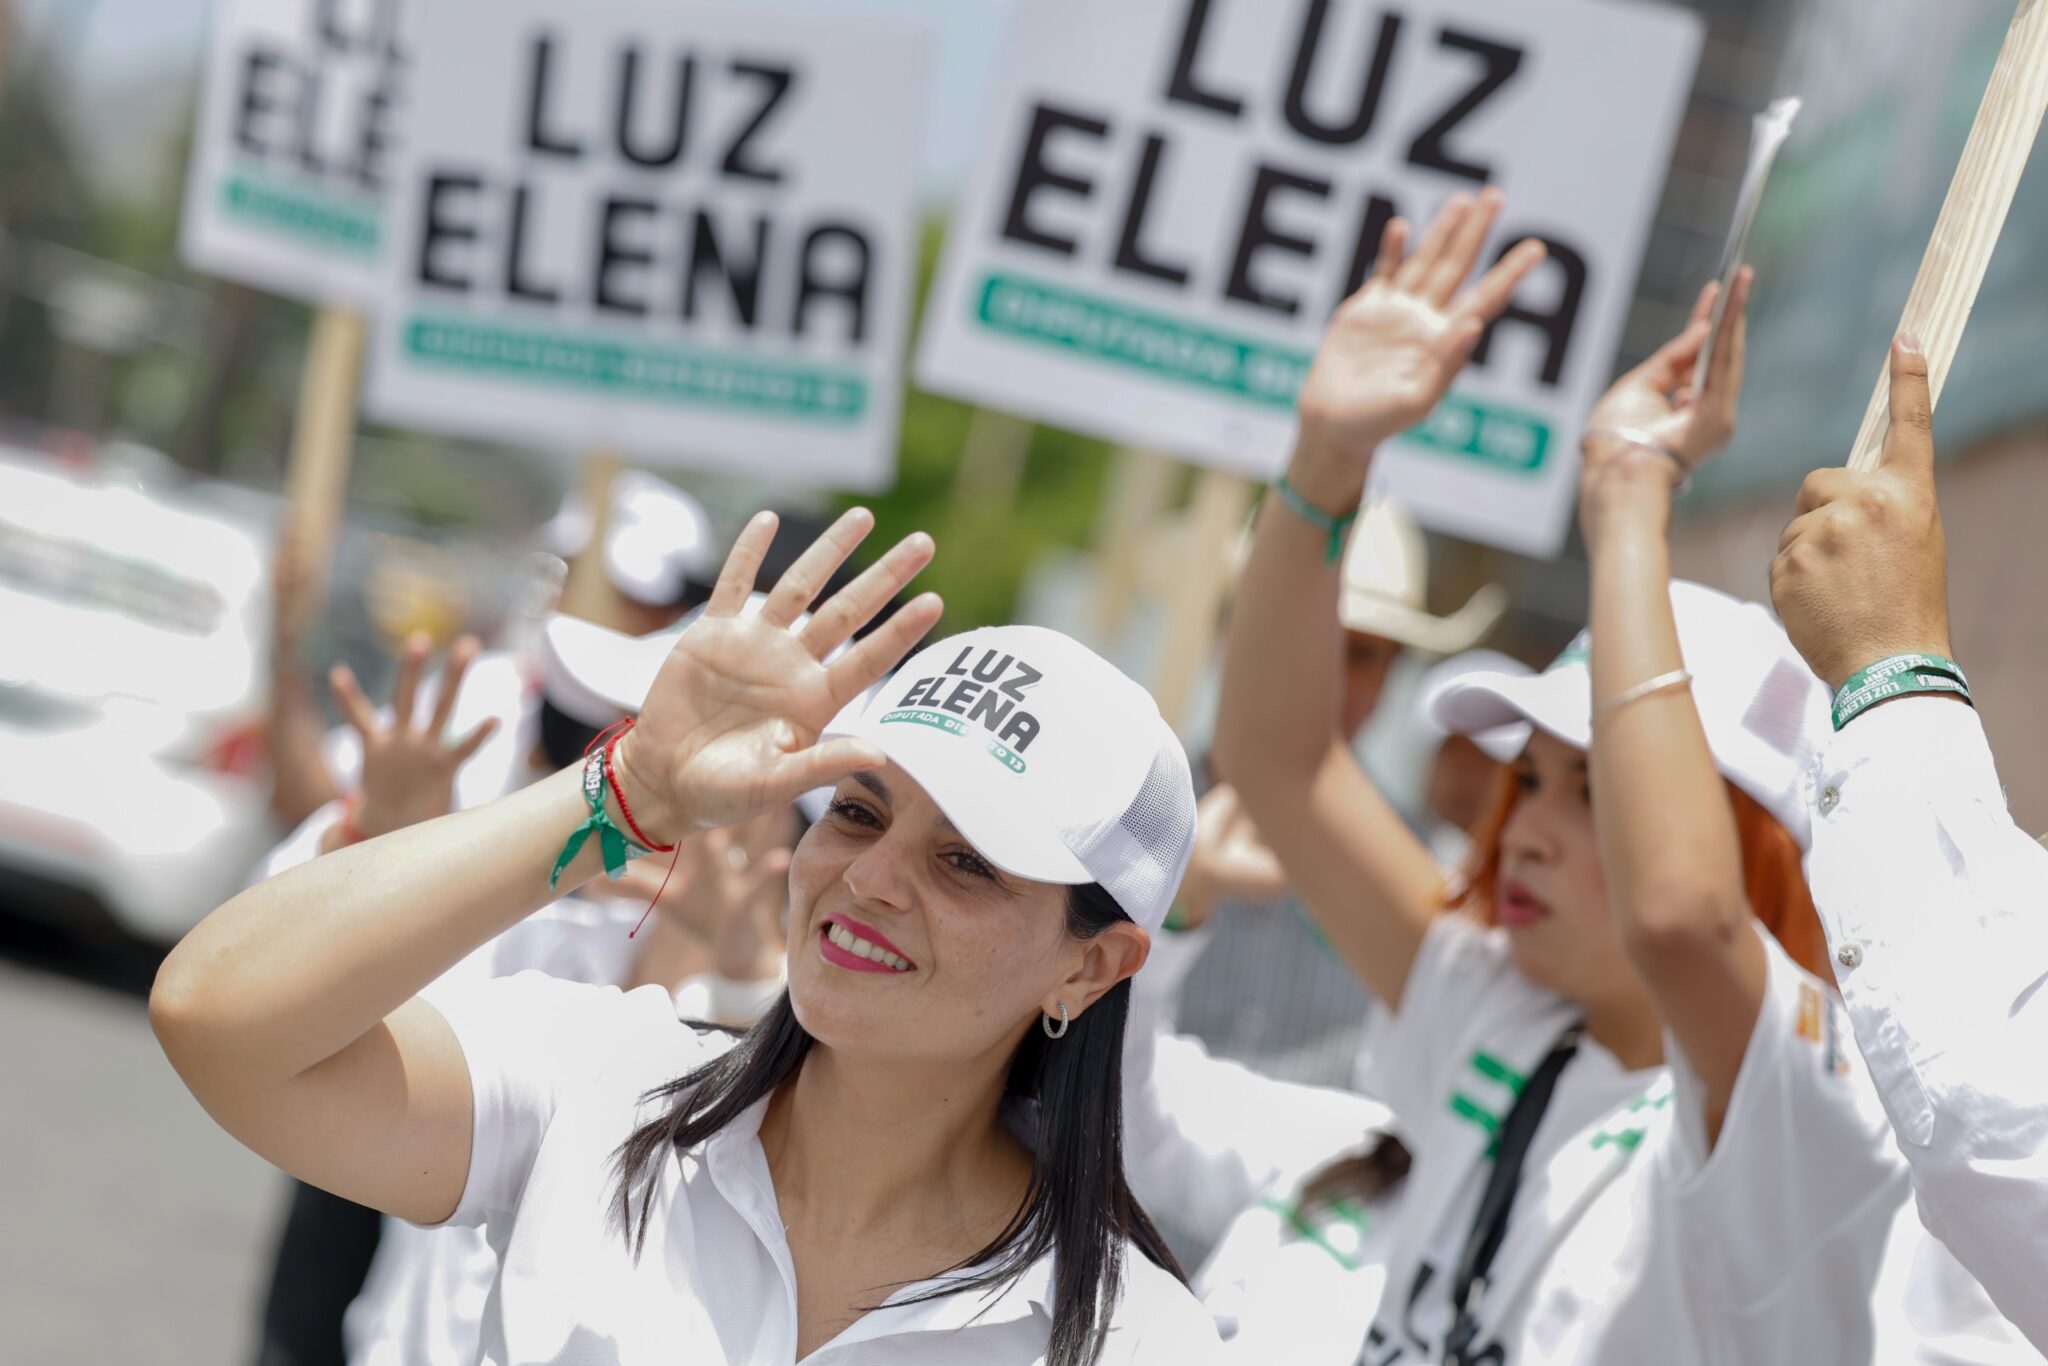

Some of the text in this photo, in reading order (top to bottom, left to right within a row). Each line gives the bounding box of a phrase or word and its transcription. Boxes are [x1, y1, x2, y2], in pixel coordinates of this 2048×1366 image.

[526, 36, 795, 184] LUZ
[1166, 0, 1525, 182] LUZ
[416, 173, 873, 343] ELENA
[945, 646, 1043, 702] LUZ
[1872, 682, 1900, 698] LUZ
[883, 711, 1024, 771] DIPUTADA DISTO 13
[897, 677, 1040, 753] ELENA
